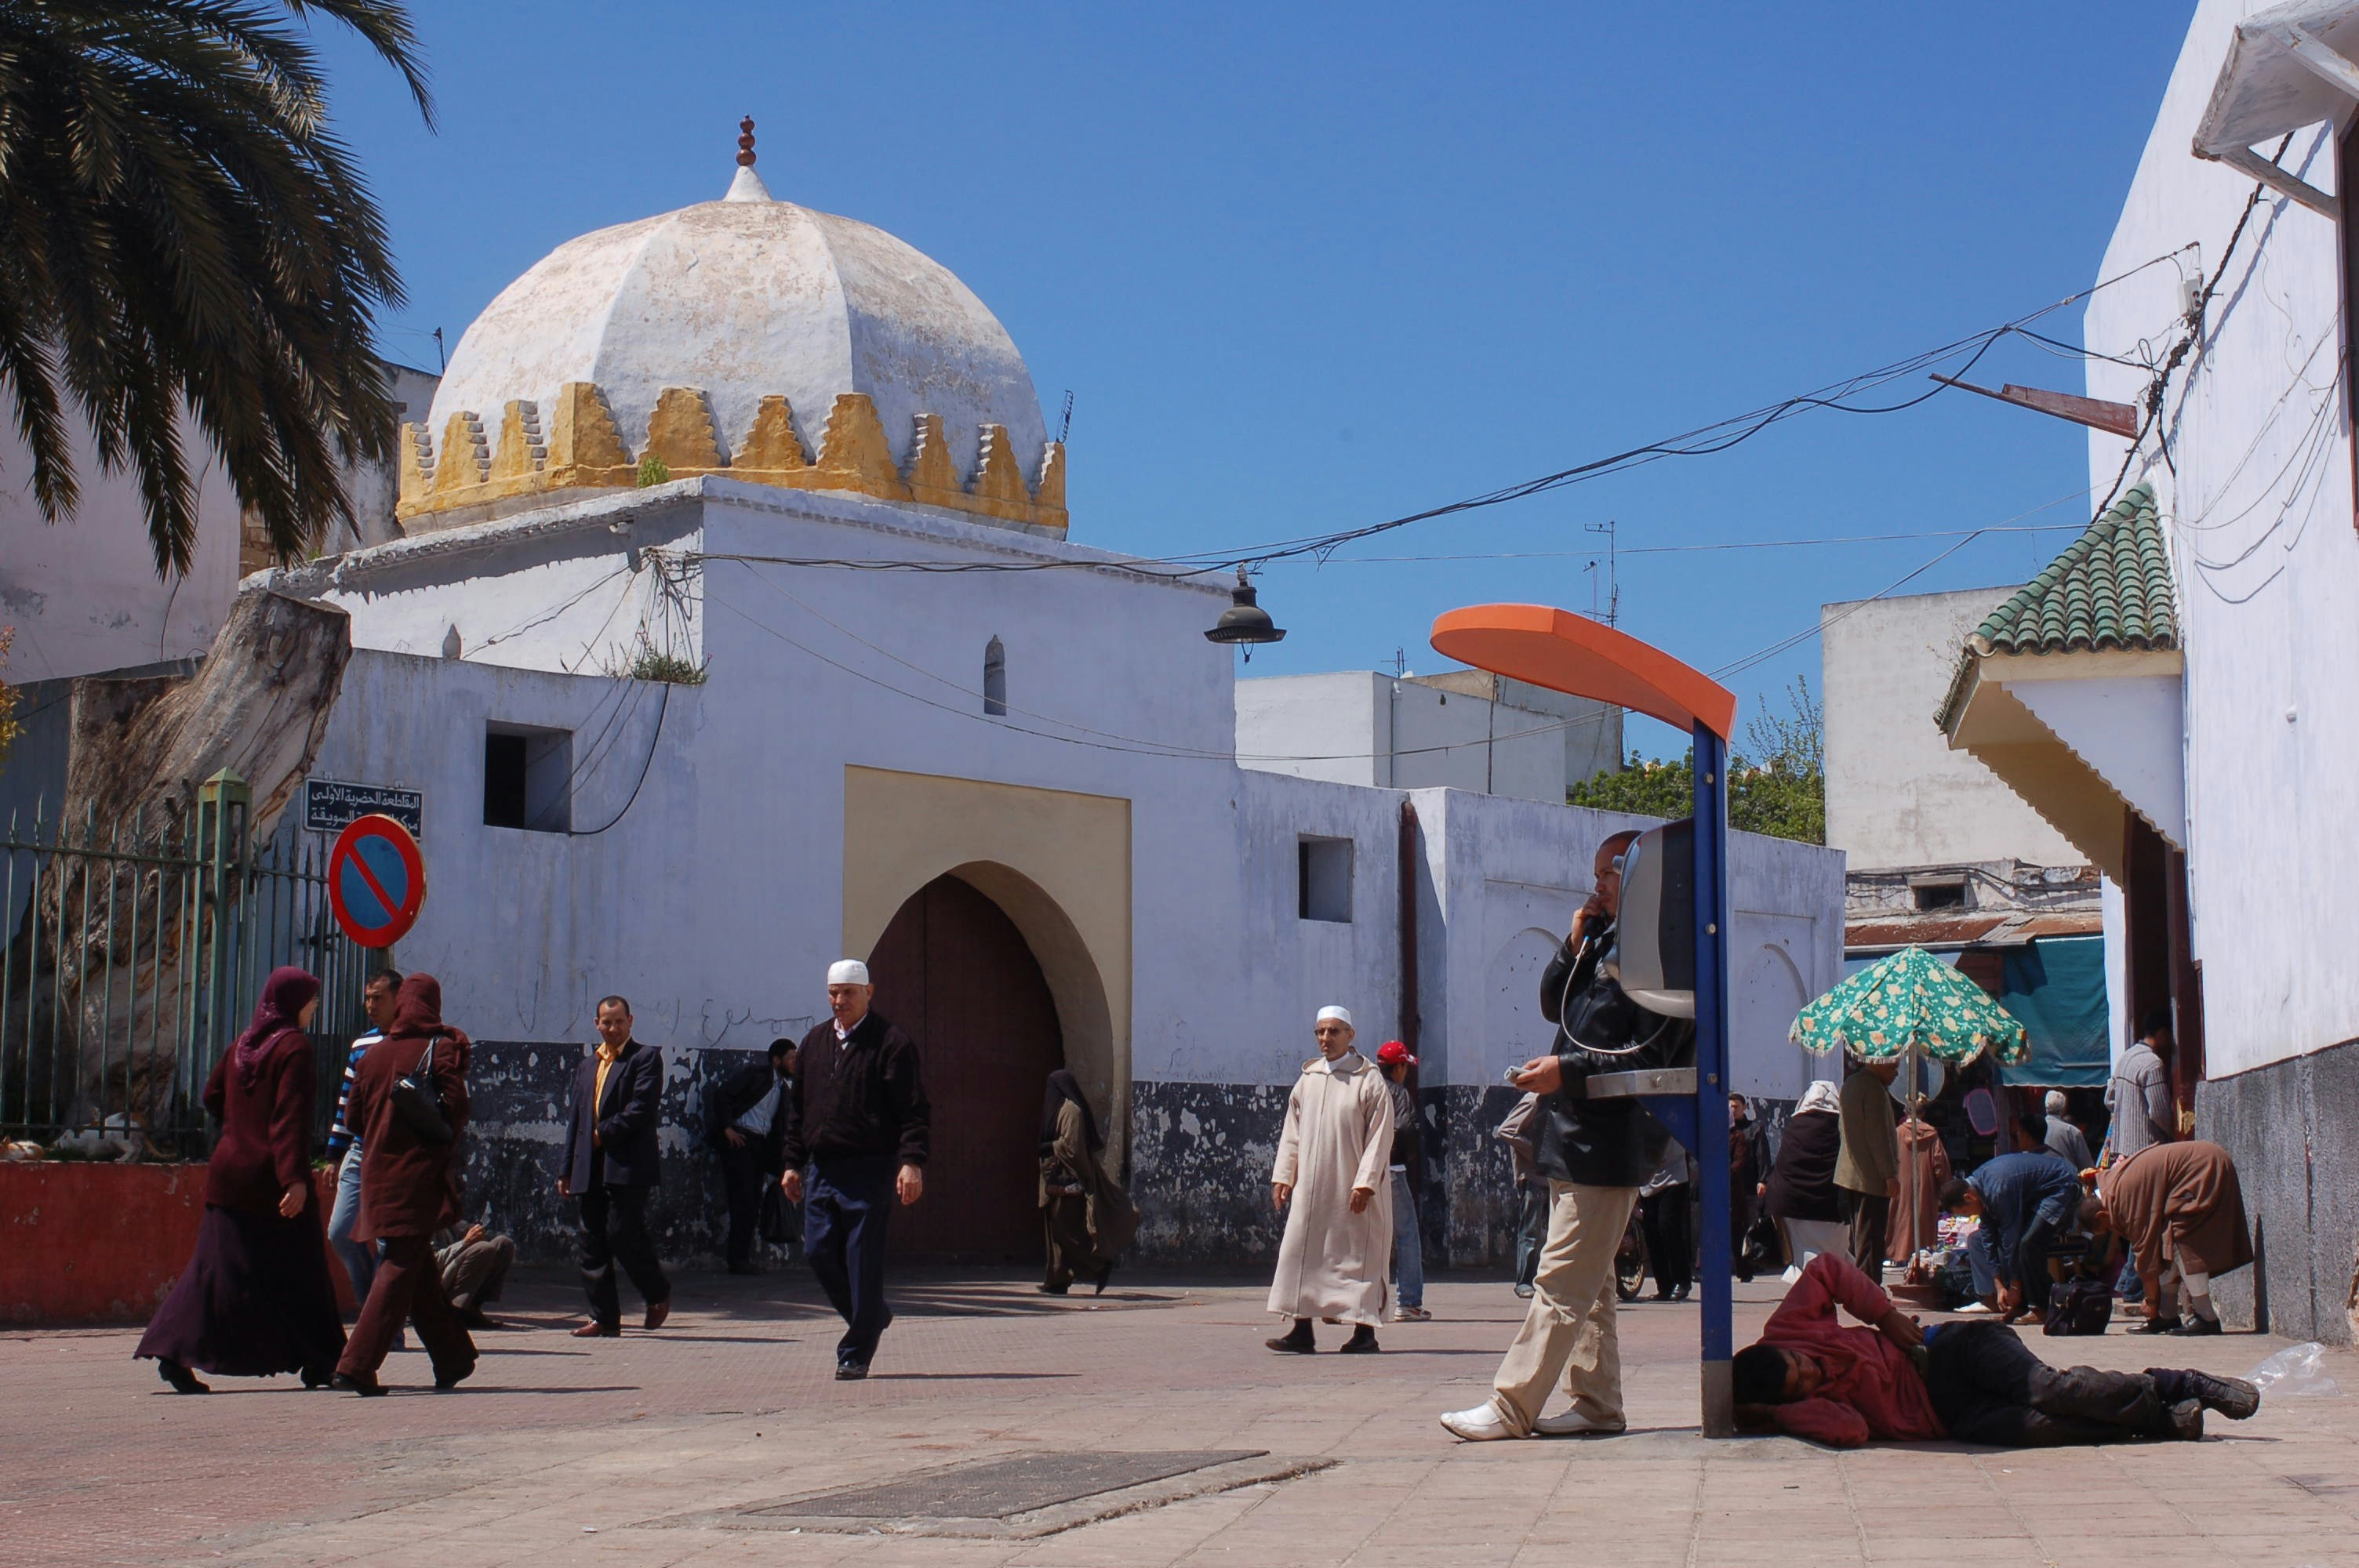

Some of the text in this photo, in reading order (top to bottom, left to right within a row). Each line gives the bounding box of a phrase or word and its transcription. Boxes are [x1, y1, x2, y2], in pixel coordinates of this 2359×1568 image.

[345, 789, 381, 807] الحضرية
[381, 793, 420, 809] المقاطعة
[311, 807, 354, 827] السويقة
[397, 815, 419, 831] مرك
